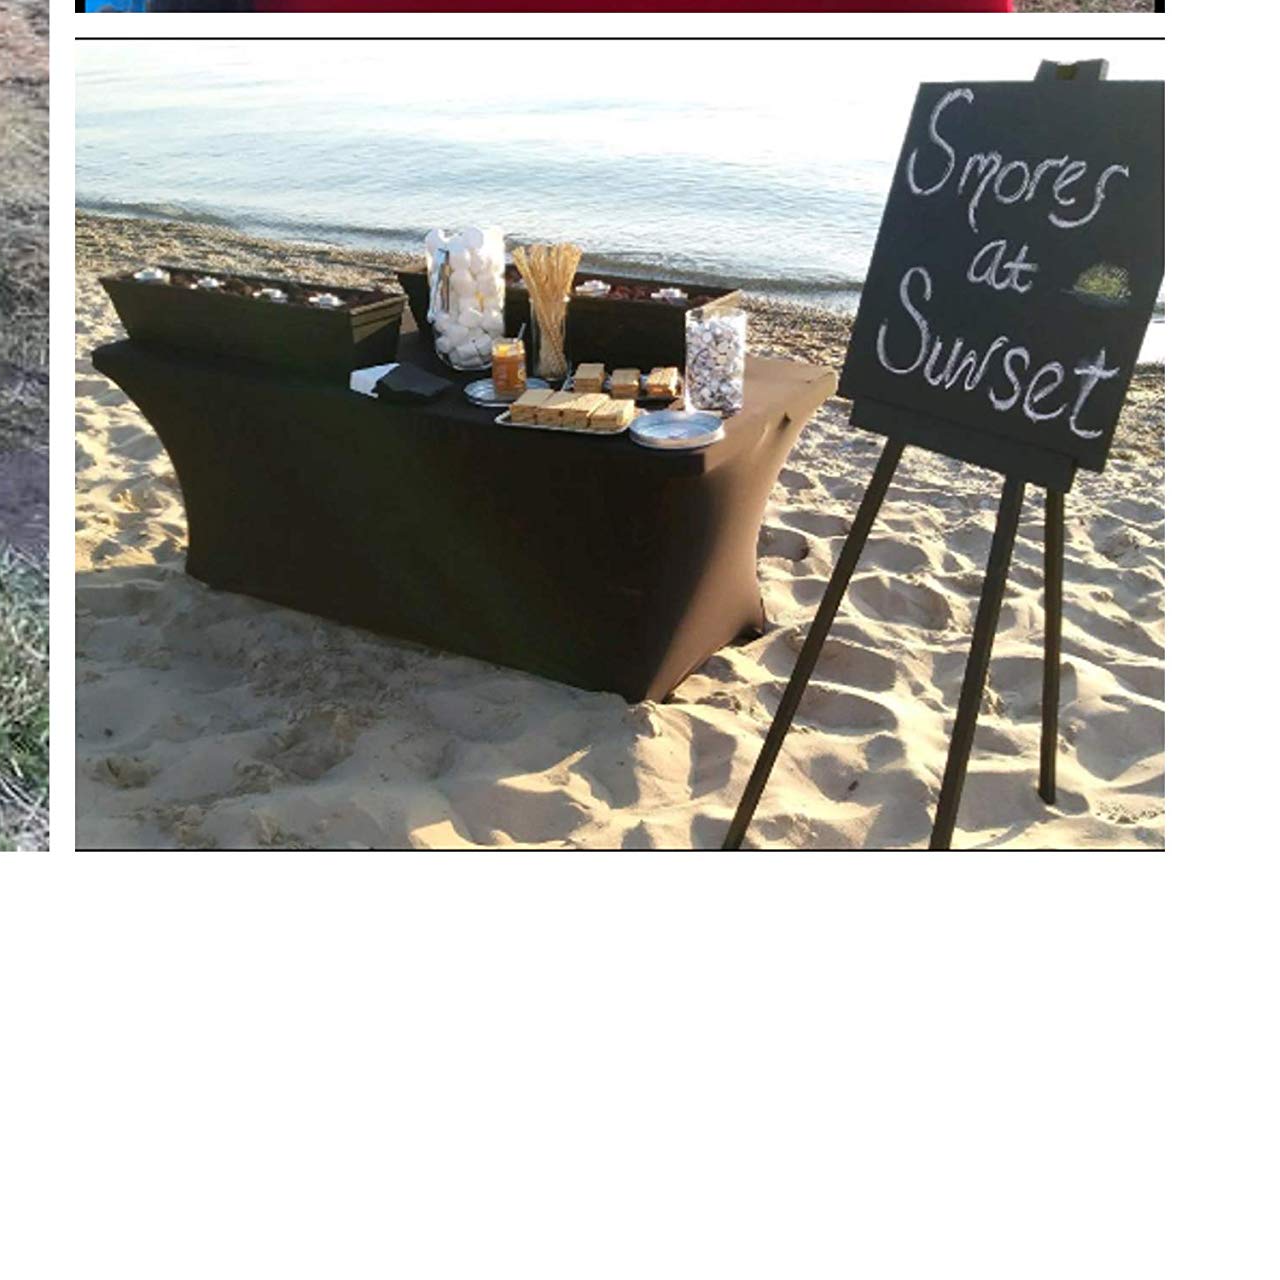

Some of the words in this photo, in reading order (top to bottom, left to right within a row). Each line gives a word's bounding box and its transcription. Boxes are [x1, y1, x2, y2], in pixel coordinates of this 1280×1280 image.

[907, 88, 1130, 233] Smores
[967, 239, 1040, 294] at
[877, 266, 1120, 440] Sunset
